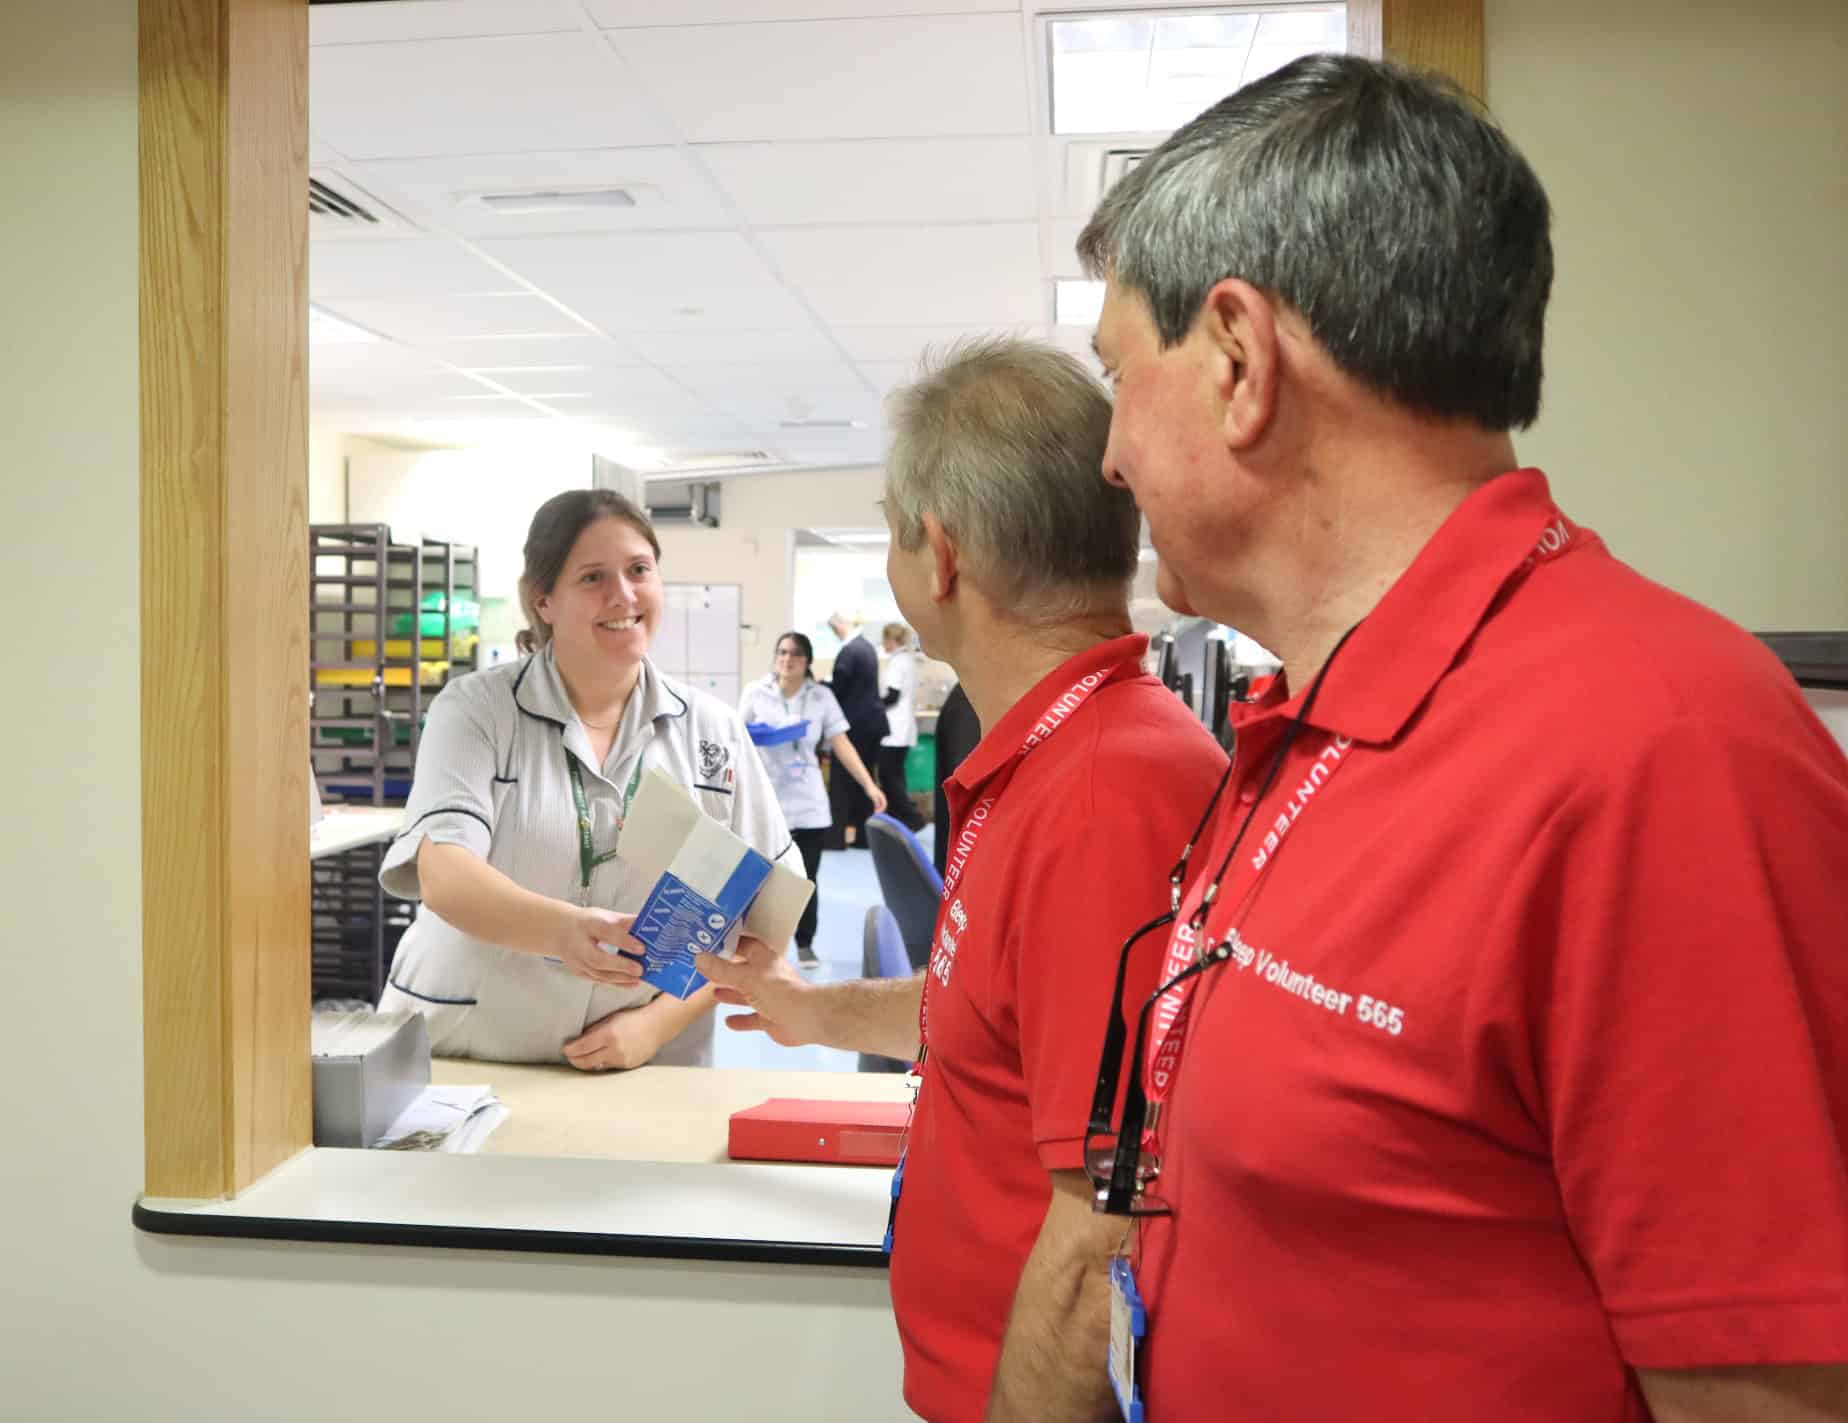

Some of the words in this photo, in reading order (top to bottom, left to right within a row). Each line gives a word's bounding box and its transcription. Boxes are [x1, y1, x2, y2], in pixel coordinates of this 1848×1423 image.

[943, 797, 995, 901] VOLUNTEER
[1255, 948, 1353, 1016] Volunteer
[1356, 993, 1405, 1037] 565
